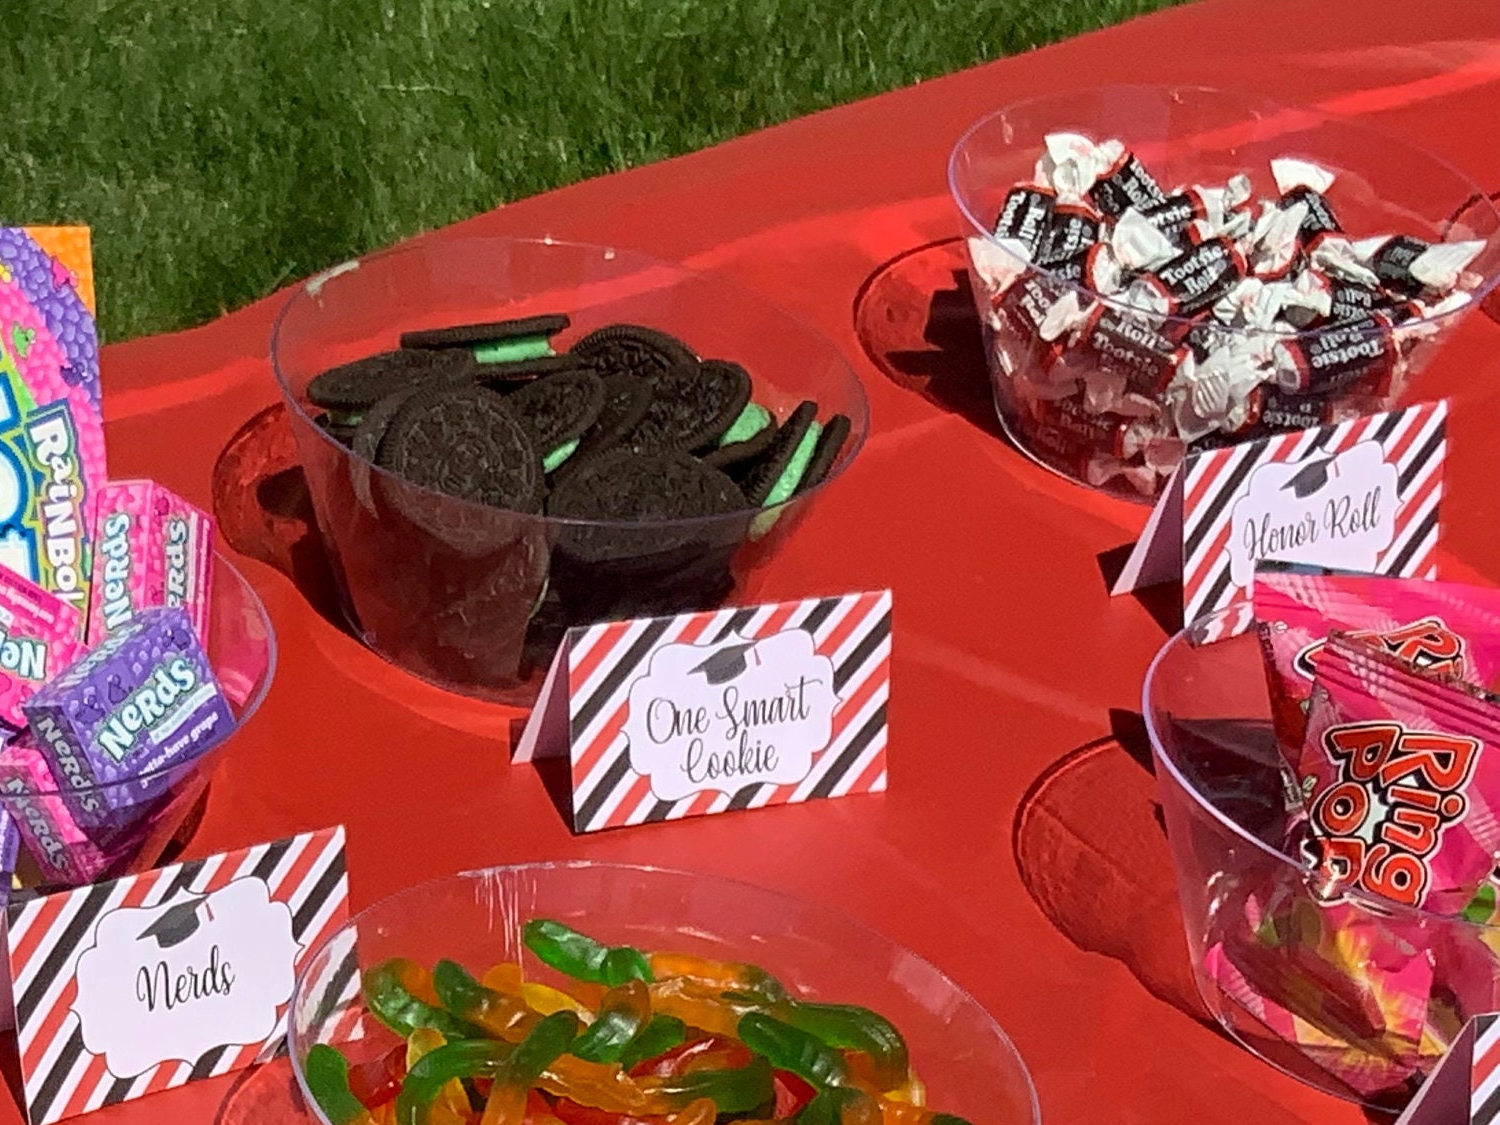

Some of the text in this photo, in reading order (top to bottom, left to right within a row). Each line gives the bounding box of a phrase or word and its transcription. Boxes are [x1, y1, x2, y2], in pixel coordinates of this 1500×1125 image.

[1159, 245, 1225, 286] Tootsie
[1183, 263, 1219, 295] Roll
[1093, 331, 1161, 378] Tootsie
[1311, 338, 1386, 369] Tootsie
[1243, 485, 1382, 562] Honor Roll
[188, 710, 220, 743] grape
[646, 675, 824, 745] One Smart
[679, 729, 780, 784] Cookie
[135, 943, 237, 1013] Nerds
